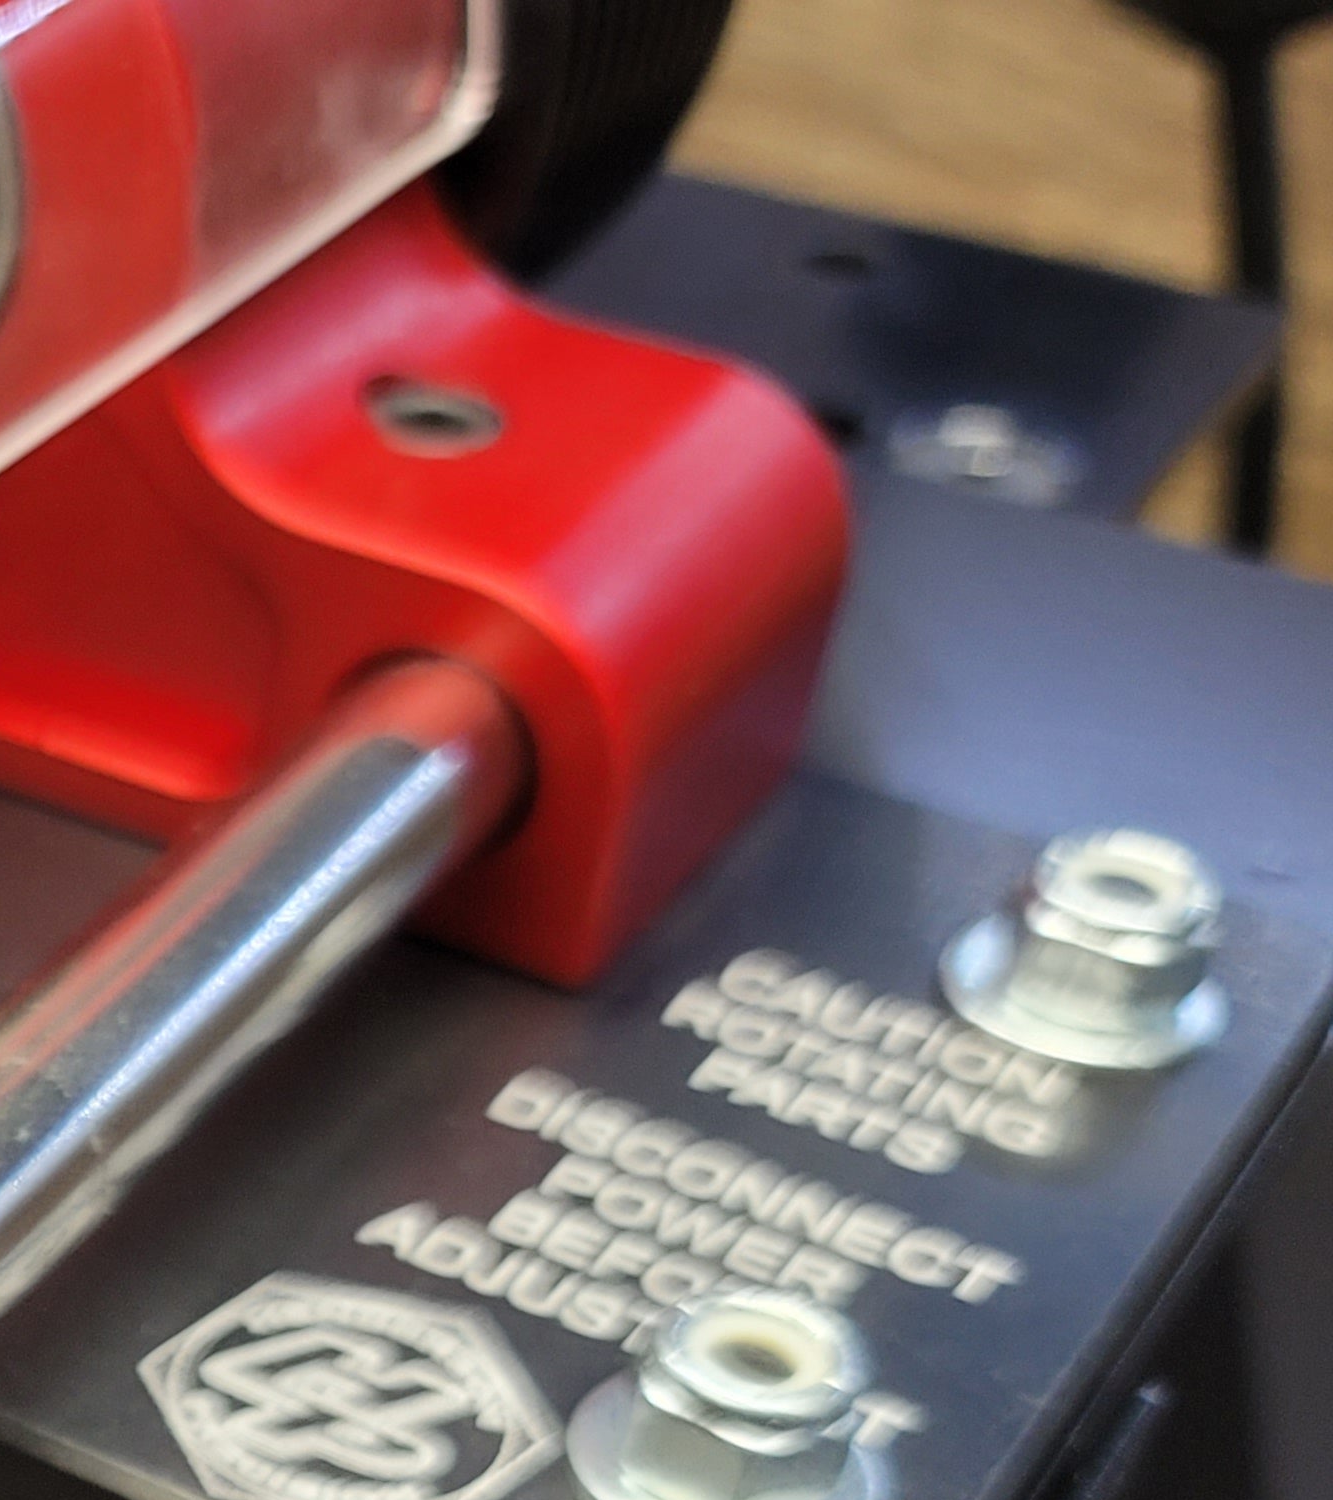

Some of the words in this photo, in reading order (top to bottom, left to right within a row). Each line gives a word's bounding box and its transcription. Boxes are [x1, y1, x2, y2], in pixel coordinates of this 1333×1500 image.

[661, 978, 1068, 1158] ROTATING
[719, 948, 1083, 1104] CAUTION
[688, 1046, 963, 1173] PARTS
[485, 1068, 1025, 1304] DISCONNECT
[486, 1190, 743, 1308] BEFO
[540, 1153, 873, 1300] POWER
